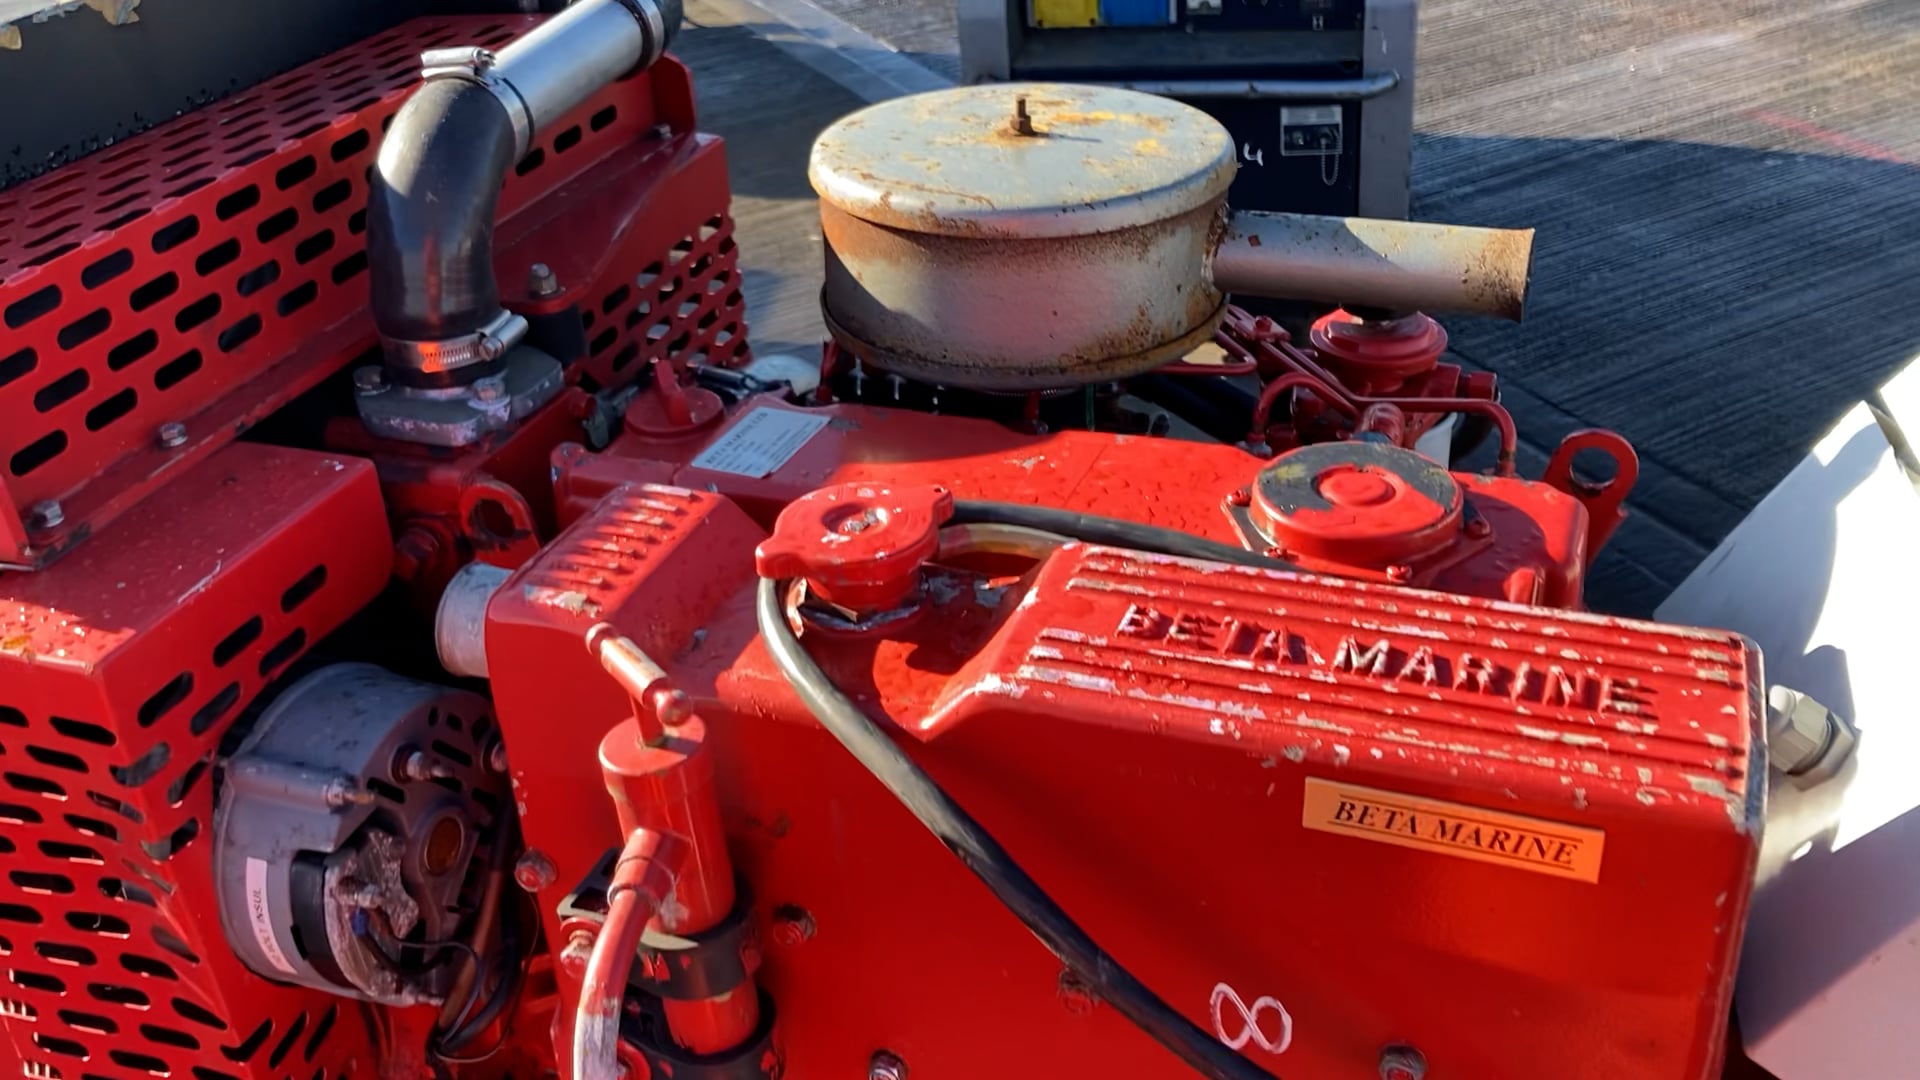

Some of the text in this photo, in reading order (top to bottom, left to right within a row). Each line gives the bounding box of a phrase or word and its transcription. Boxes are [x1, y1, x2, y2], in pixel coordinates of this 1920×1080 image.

[1237, 142, 1264, 168] 4
[1115, 603, 1657, 717] BETA MARINE
[1334, 800, 1579, 865] BETA MARINE
